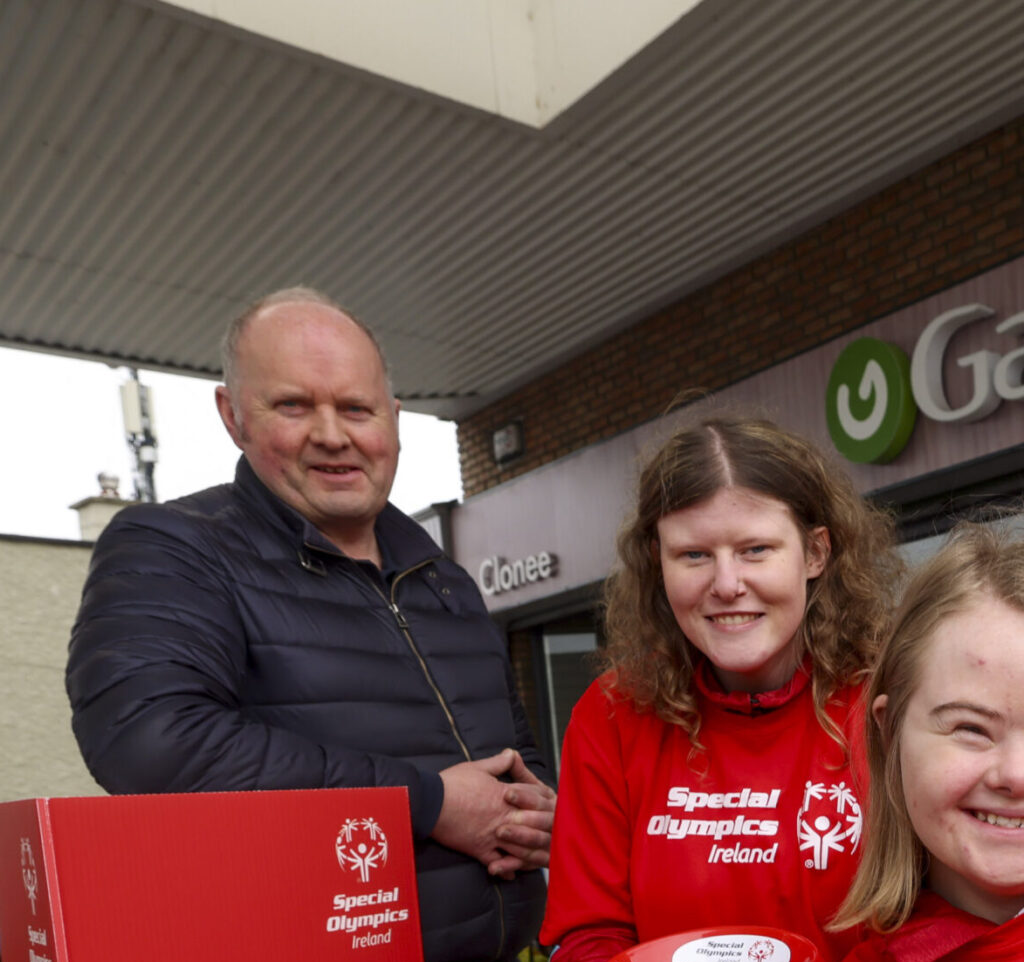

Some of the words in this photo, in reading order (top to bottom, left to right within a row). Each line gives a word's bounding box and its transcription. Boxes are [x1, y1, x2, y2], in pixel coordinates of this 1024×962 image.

[480, 551, 553, 596] Clonee
[666, 786, 781, 812] Special
[647, 814, 779, 840] Olympics
[707, 842, 779, 864] Ireland
[333, 887, 399, 912] Special
[326, 908, 409, 933] Olympics
[352, 928, 392, 950] Ireland
[707, 941, 744, 950] Special
[696, 949, 742, 958] Olympics
